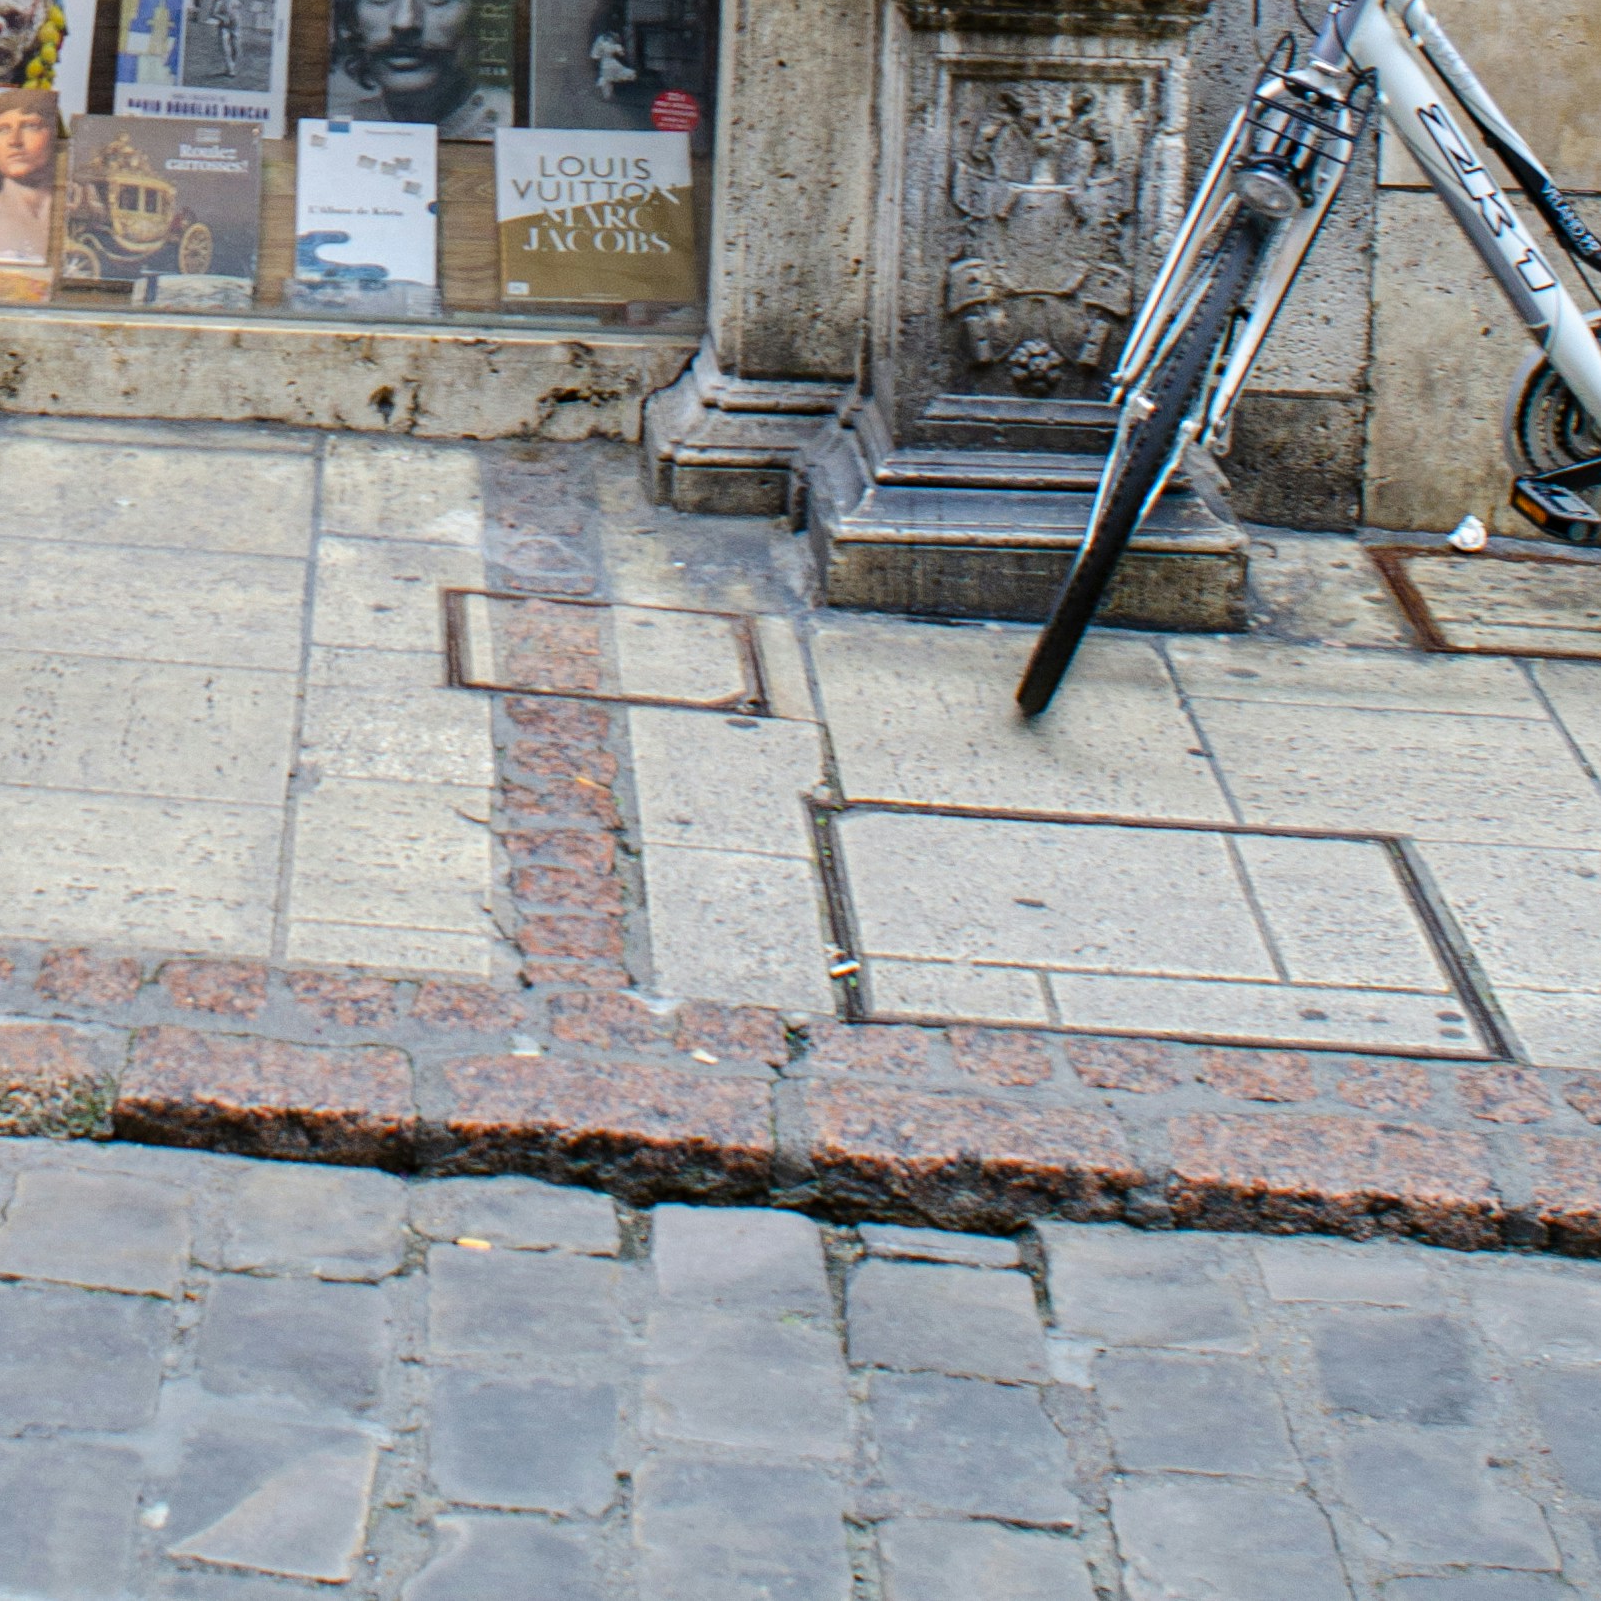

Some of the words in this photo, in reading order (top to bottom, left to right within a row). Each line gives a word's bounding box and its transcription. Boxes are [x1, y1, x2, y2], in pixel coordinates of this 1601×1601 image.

[179, 143, 237, 160] Roulez
[538, 155, 651, 180] LOUIS
[511, 178, 681, 206] VUITTON
[541, 204, 654, 229] MARC
[522, 226, 672, 255] JACOBS
